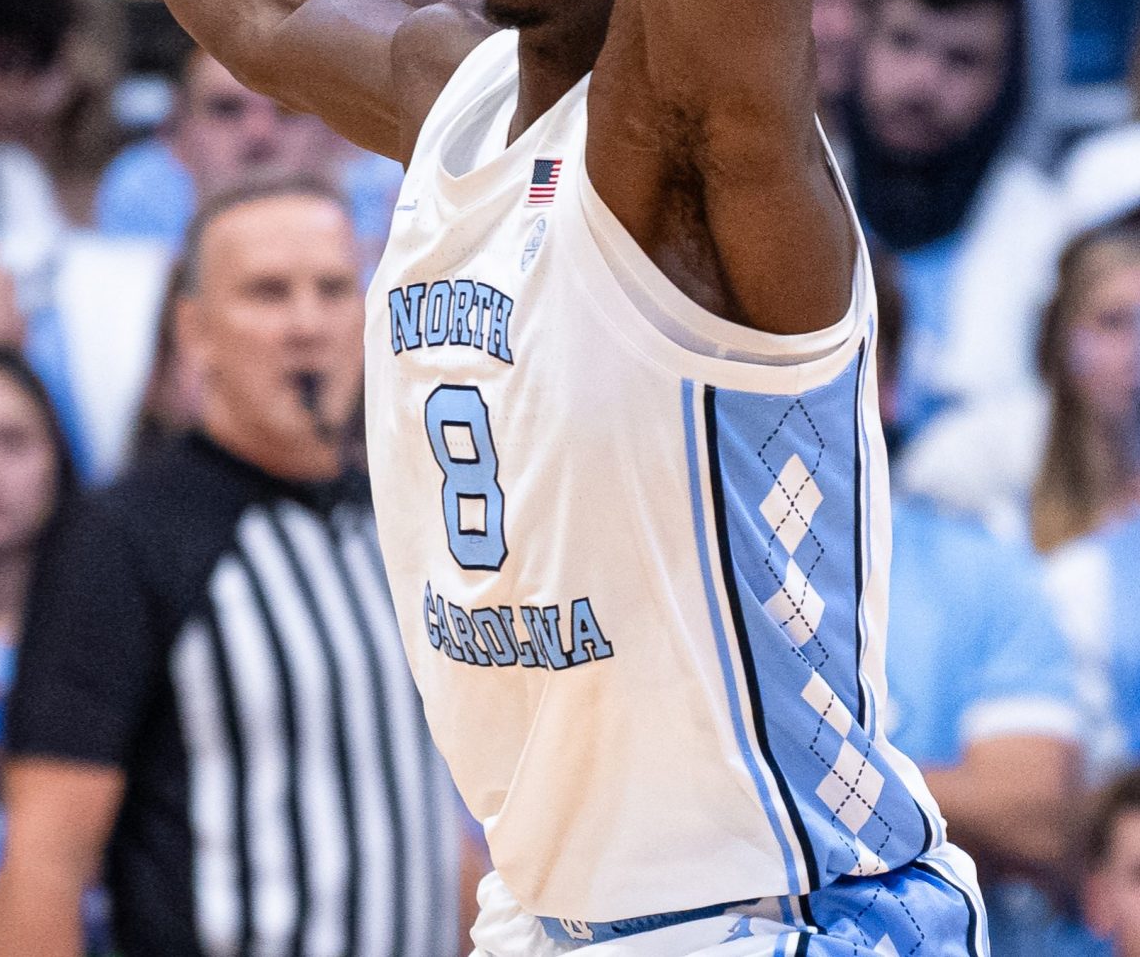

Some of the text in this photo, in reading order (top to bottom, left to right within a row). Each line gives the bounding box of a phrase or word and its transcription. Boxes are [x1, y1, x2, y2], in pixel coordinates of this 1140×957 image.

[388, 279, 514, 365] NORTH
[425, 384, 509, 571] 8
[423, 580, 614, 671] CAROLINA
